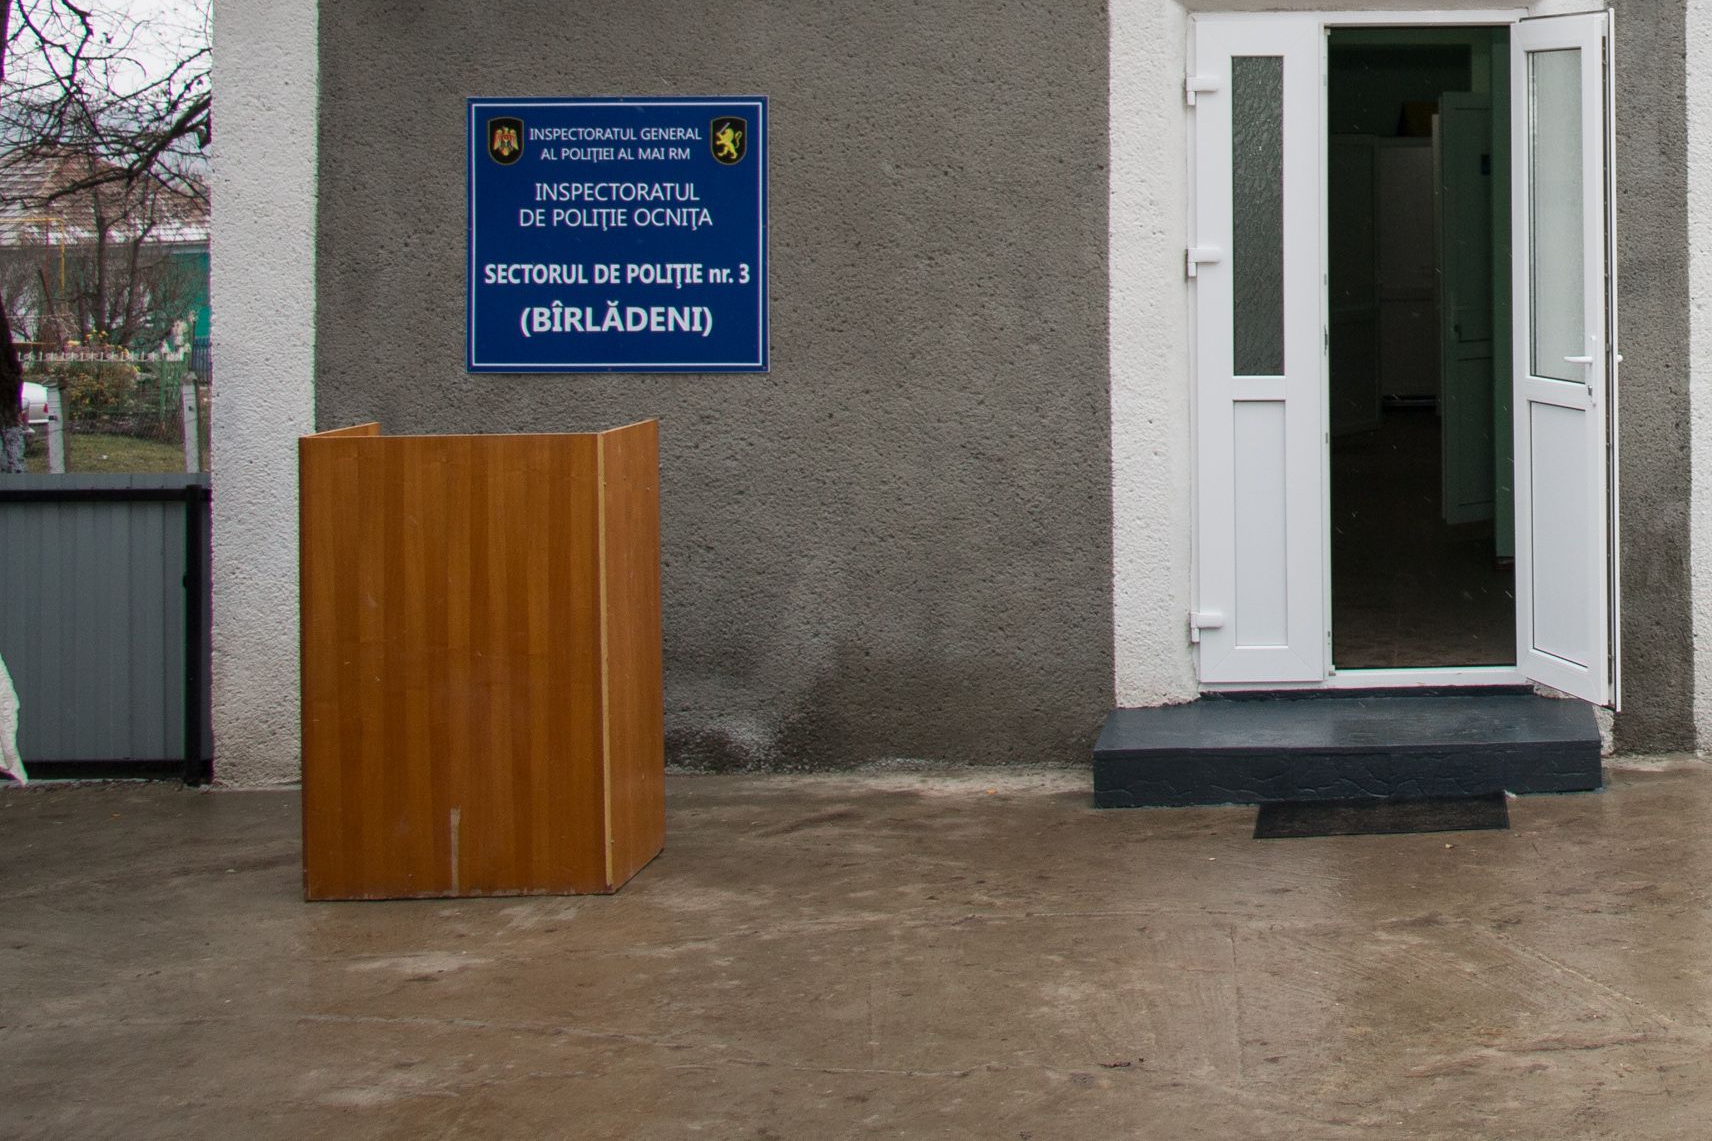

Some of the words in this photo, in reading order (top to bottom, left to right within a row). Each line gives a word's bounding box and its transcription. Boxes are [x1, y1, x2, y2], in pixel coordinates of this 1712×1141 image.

[529, 127, 637, 141] INSPECTORATUL
[640, 127, 702, 141] GENERAL
[540, 147, 557, 160] AL
[618, 147, 635, 160] AL
[638, 147, 665, 160] MAI
[668, 147, 690, 160] RM
[535, 182, 700, 201] INSPECTORATUL
[519, 208, 546, 227] DE
[483, 263, 589, 284] SECTORUL
[594, 263, 621, 284] DE
[708, 267, 734, 284] nr.
[738, 263, 750, 284] 3
[519, 299, 713, 338] (BÎRLĂDENI)
